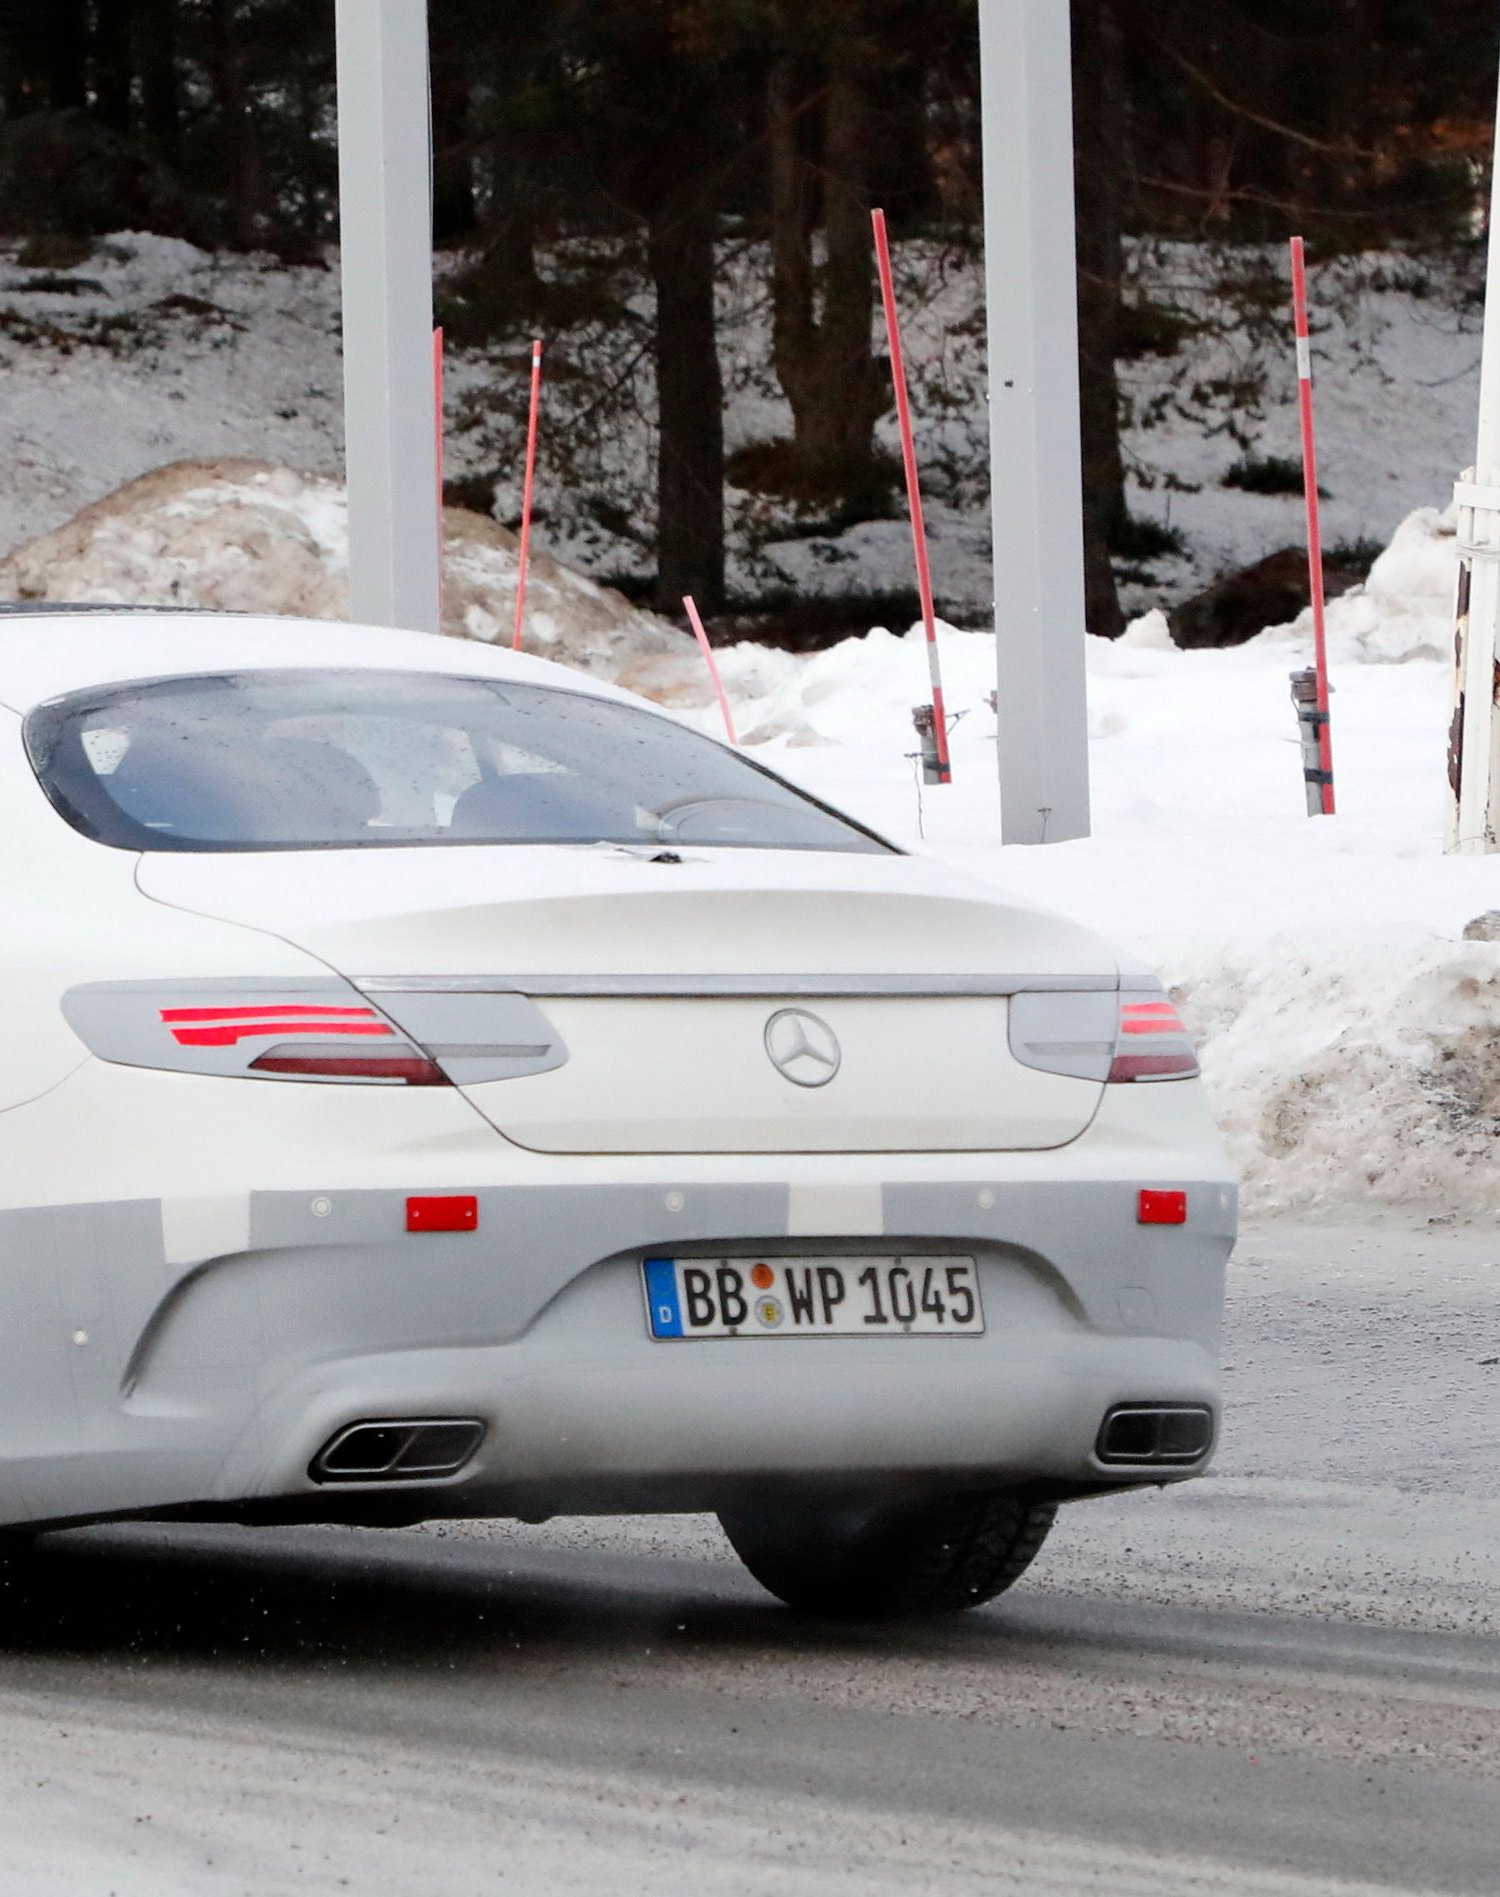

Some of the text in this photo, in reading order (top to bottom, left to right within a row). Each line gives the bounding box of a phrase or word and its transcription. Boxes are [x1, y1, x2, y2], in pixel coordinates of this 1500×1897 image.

[659, 1306, 673, 1323] D
[683, 1267, 975, 1327] BB WP 1045
